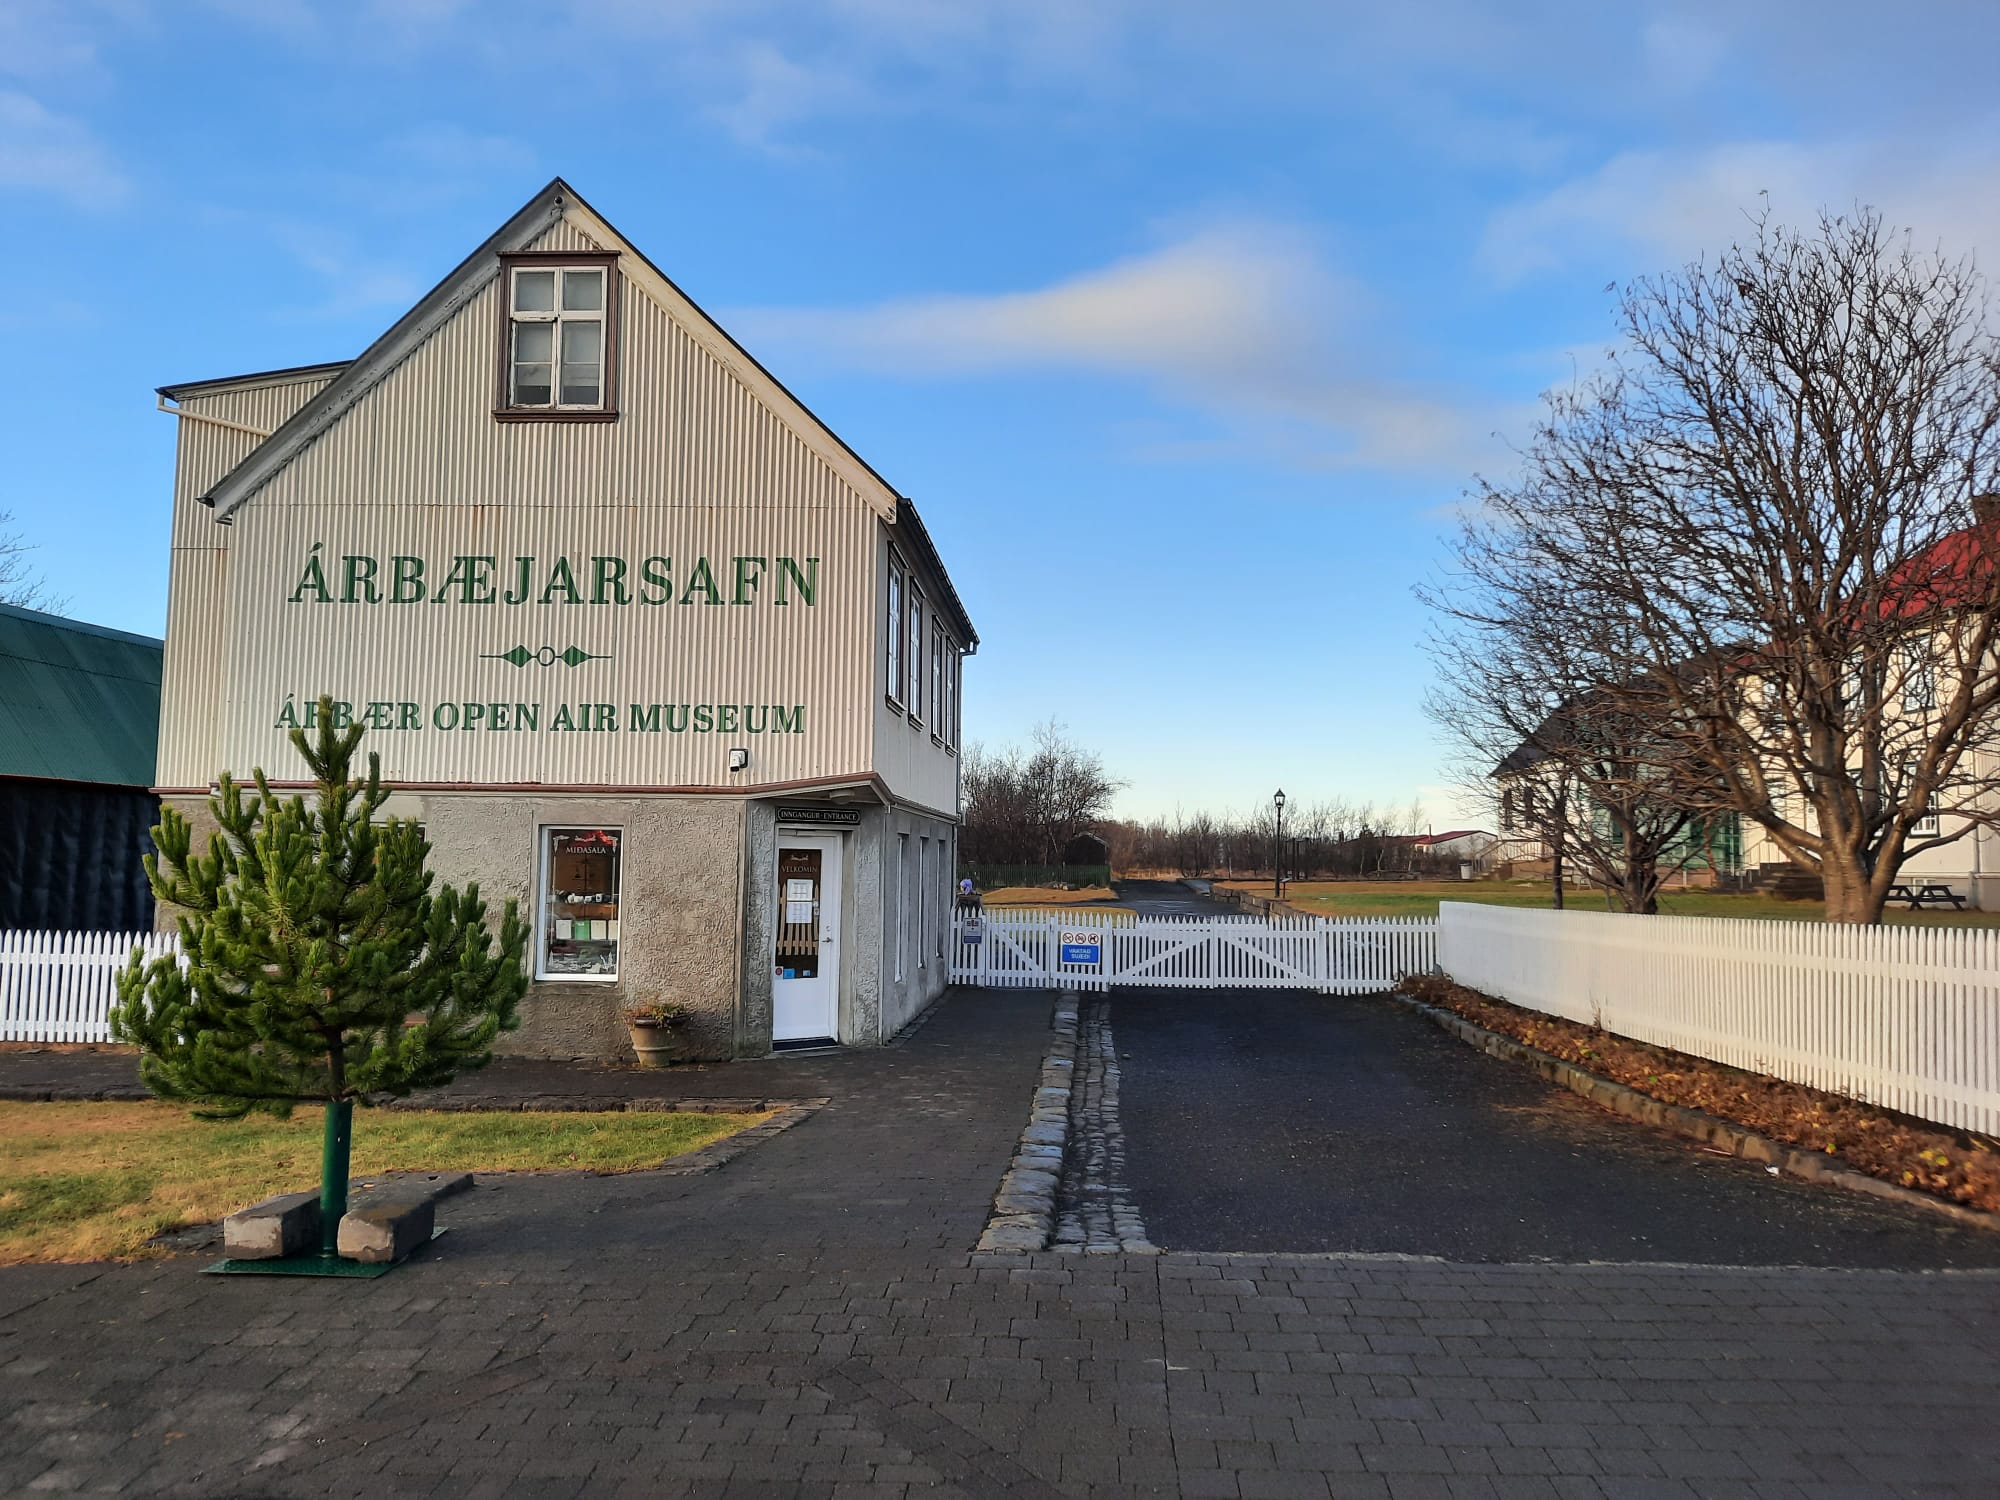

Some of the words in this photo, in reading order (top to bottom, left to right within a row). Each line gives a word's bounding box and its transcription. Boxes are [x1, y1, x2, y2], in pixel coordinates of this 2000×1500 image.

[287, 541, 820, 607] ÁRBÆJARSAFN
[433, 702, 540, 732] OPEN
[550, 702, 619, 733] AIR
[629, 702, 806, 735] MUSEUM
[780, 864, 818, 873] VELKOMIN
